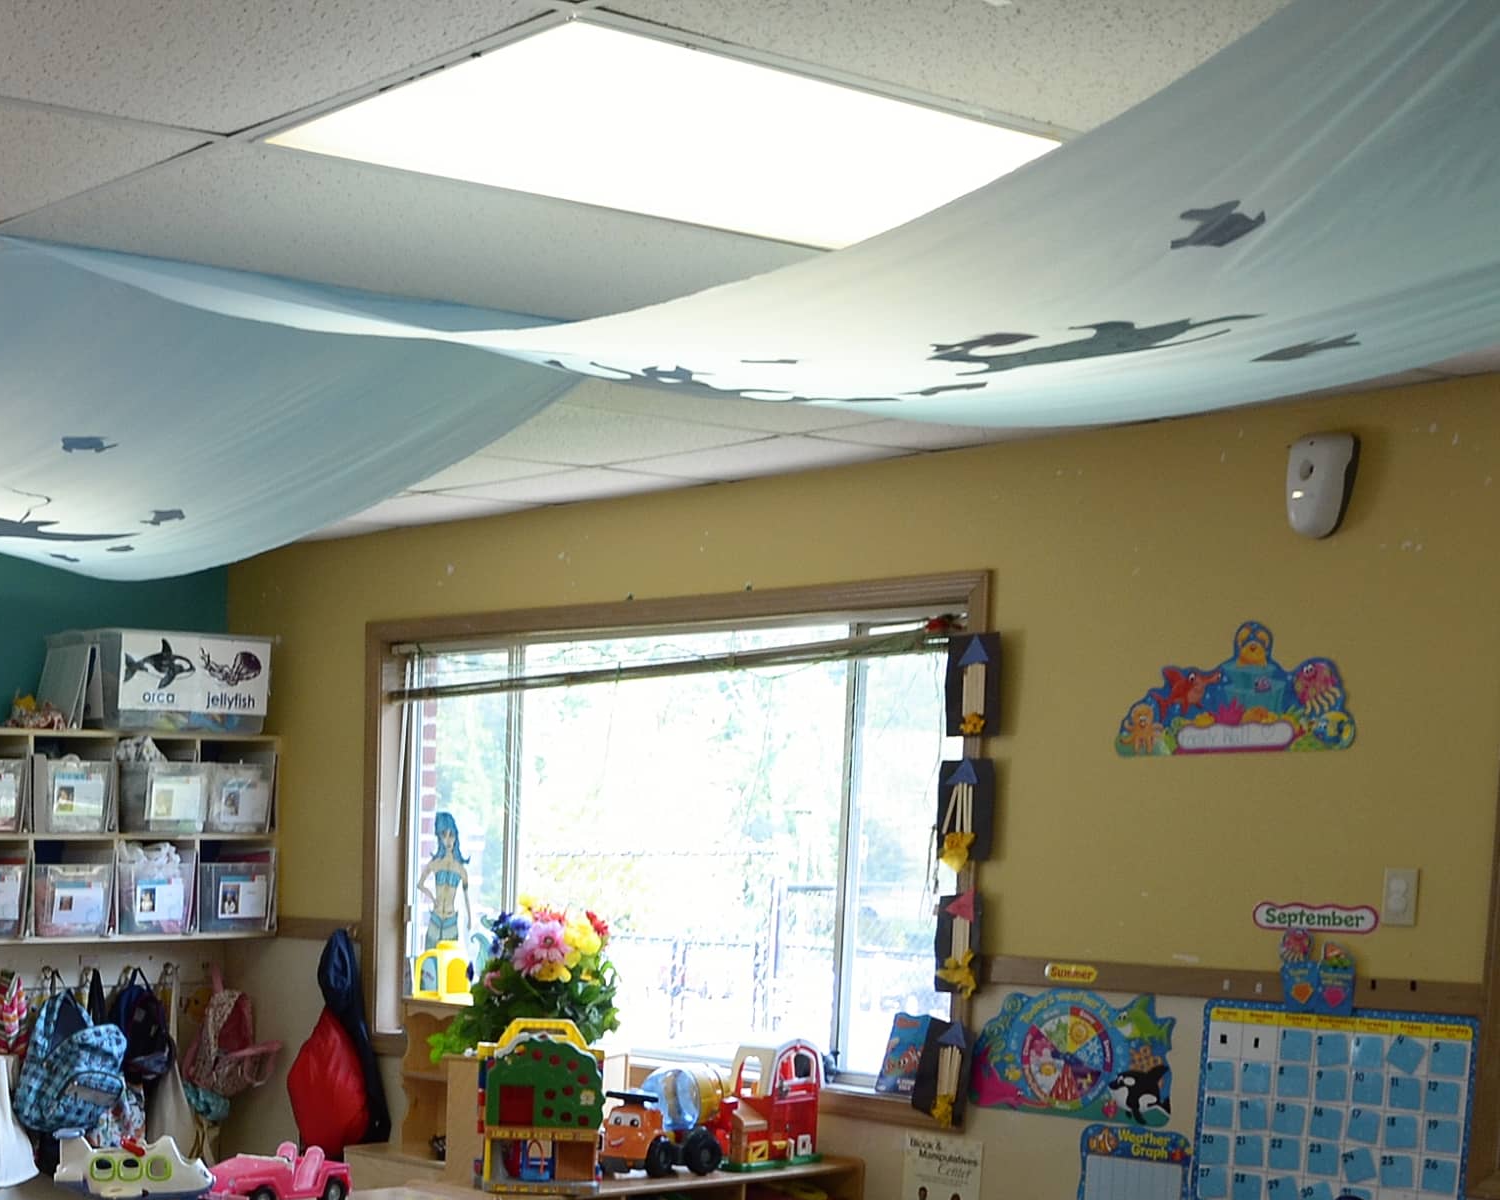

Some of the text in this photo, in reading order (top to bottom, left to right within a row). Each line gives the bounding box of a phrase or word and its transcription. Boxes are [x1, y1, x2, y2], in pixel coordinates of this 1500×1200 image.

[142, 690, 256, 710] orca jellyfish
[1265, 908, 1365, 928] September
[1050, 965, 1094, 981] Summer
[1354, 1073, 1364, 1082] 10
[1391, 1077, 1399, 1087] 11
[1428, 1081, 1438, 1091] 12
[1207, 1097, 1438, 1129] 13 14 15 16 17 18 19
[1118, 1128, 1170, 1147] Weather
[1131, 1143, 1169, 1161] Graph
[1202, 1135, 1438, 1170] 20 21 22 23 24 25 26
[1200, 1168, 1210, 1178] 27
[1235, 1173, 1246, 1183] 28
[1268, 1179, 1280, 1190] 29
[1301, 1187, 1314, 1198] 30
